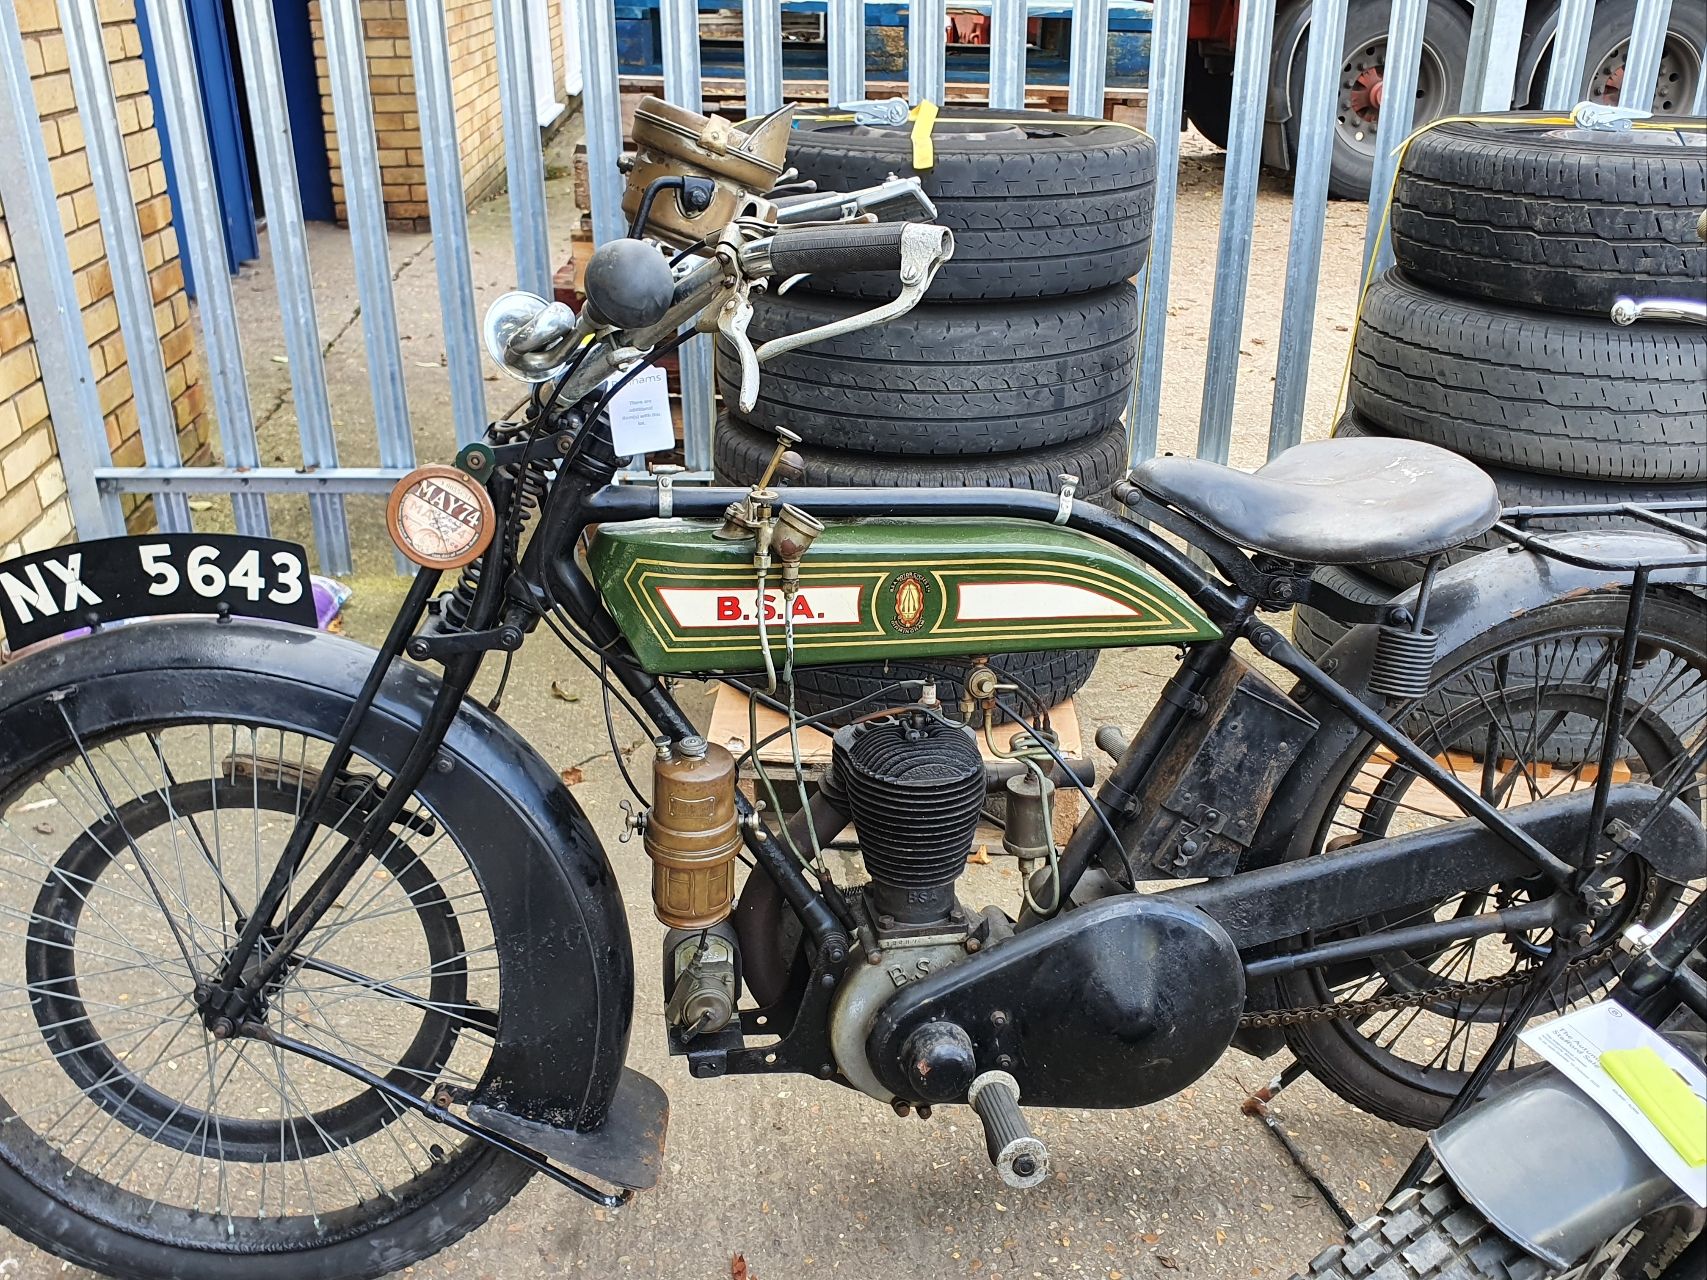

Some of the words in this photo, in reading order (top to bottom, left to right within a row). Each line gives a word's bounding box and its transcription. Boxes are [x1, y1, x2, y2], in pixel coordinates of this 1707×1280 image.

[0, 552, 103, 625] NX
[138, 543, 304, 605] 5643
[716, 594, 825, 621] B.S.A.
[907, 890, 939, 903] BSA
[1552, 1029, 1585, 1055] Stafford
[1559, 1028, 1574, 1040] The
